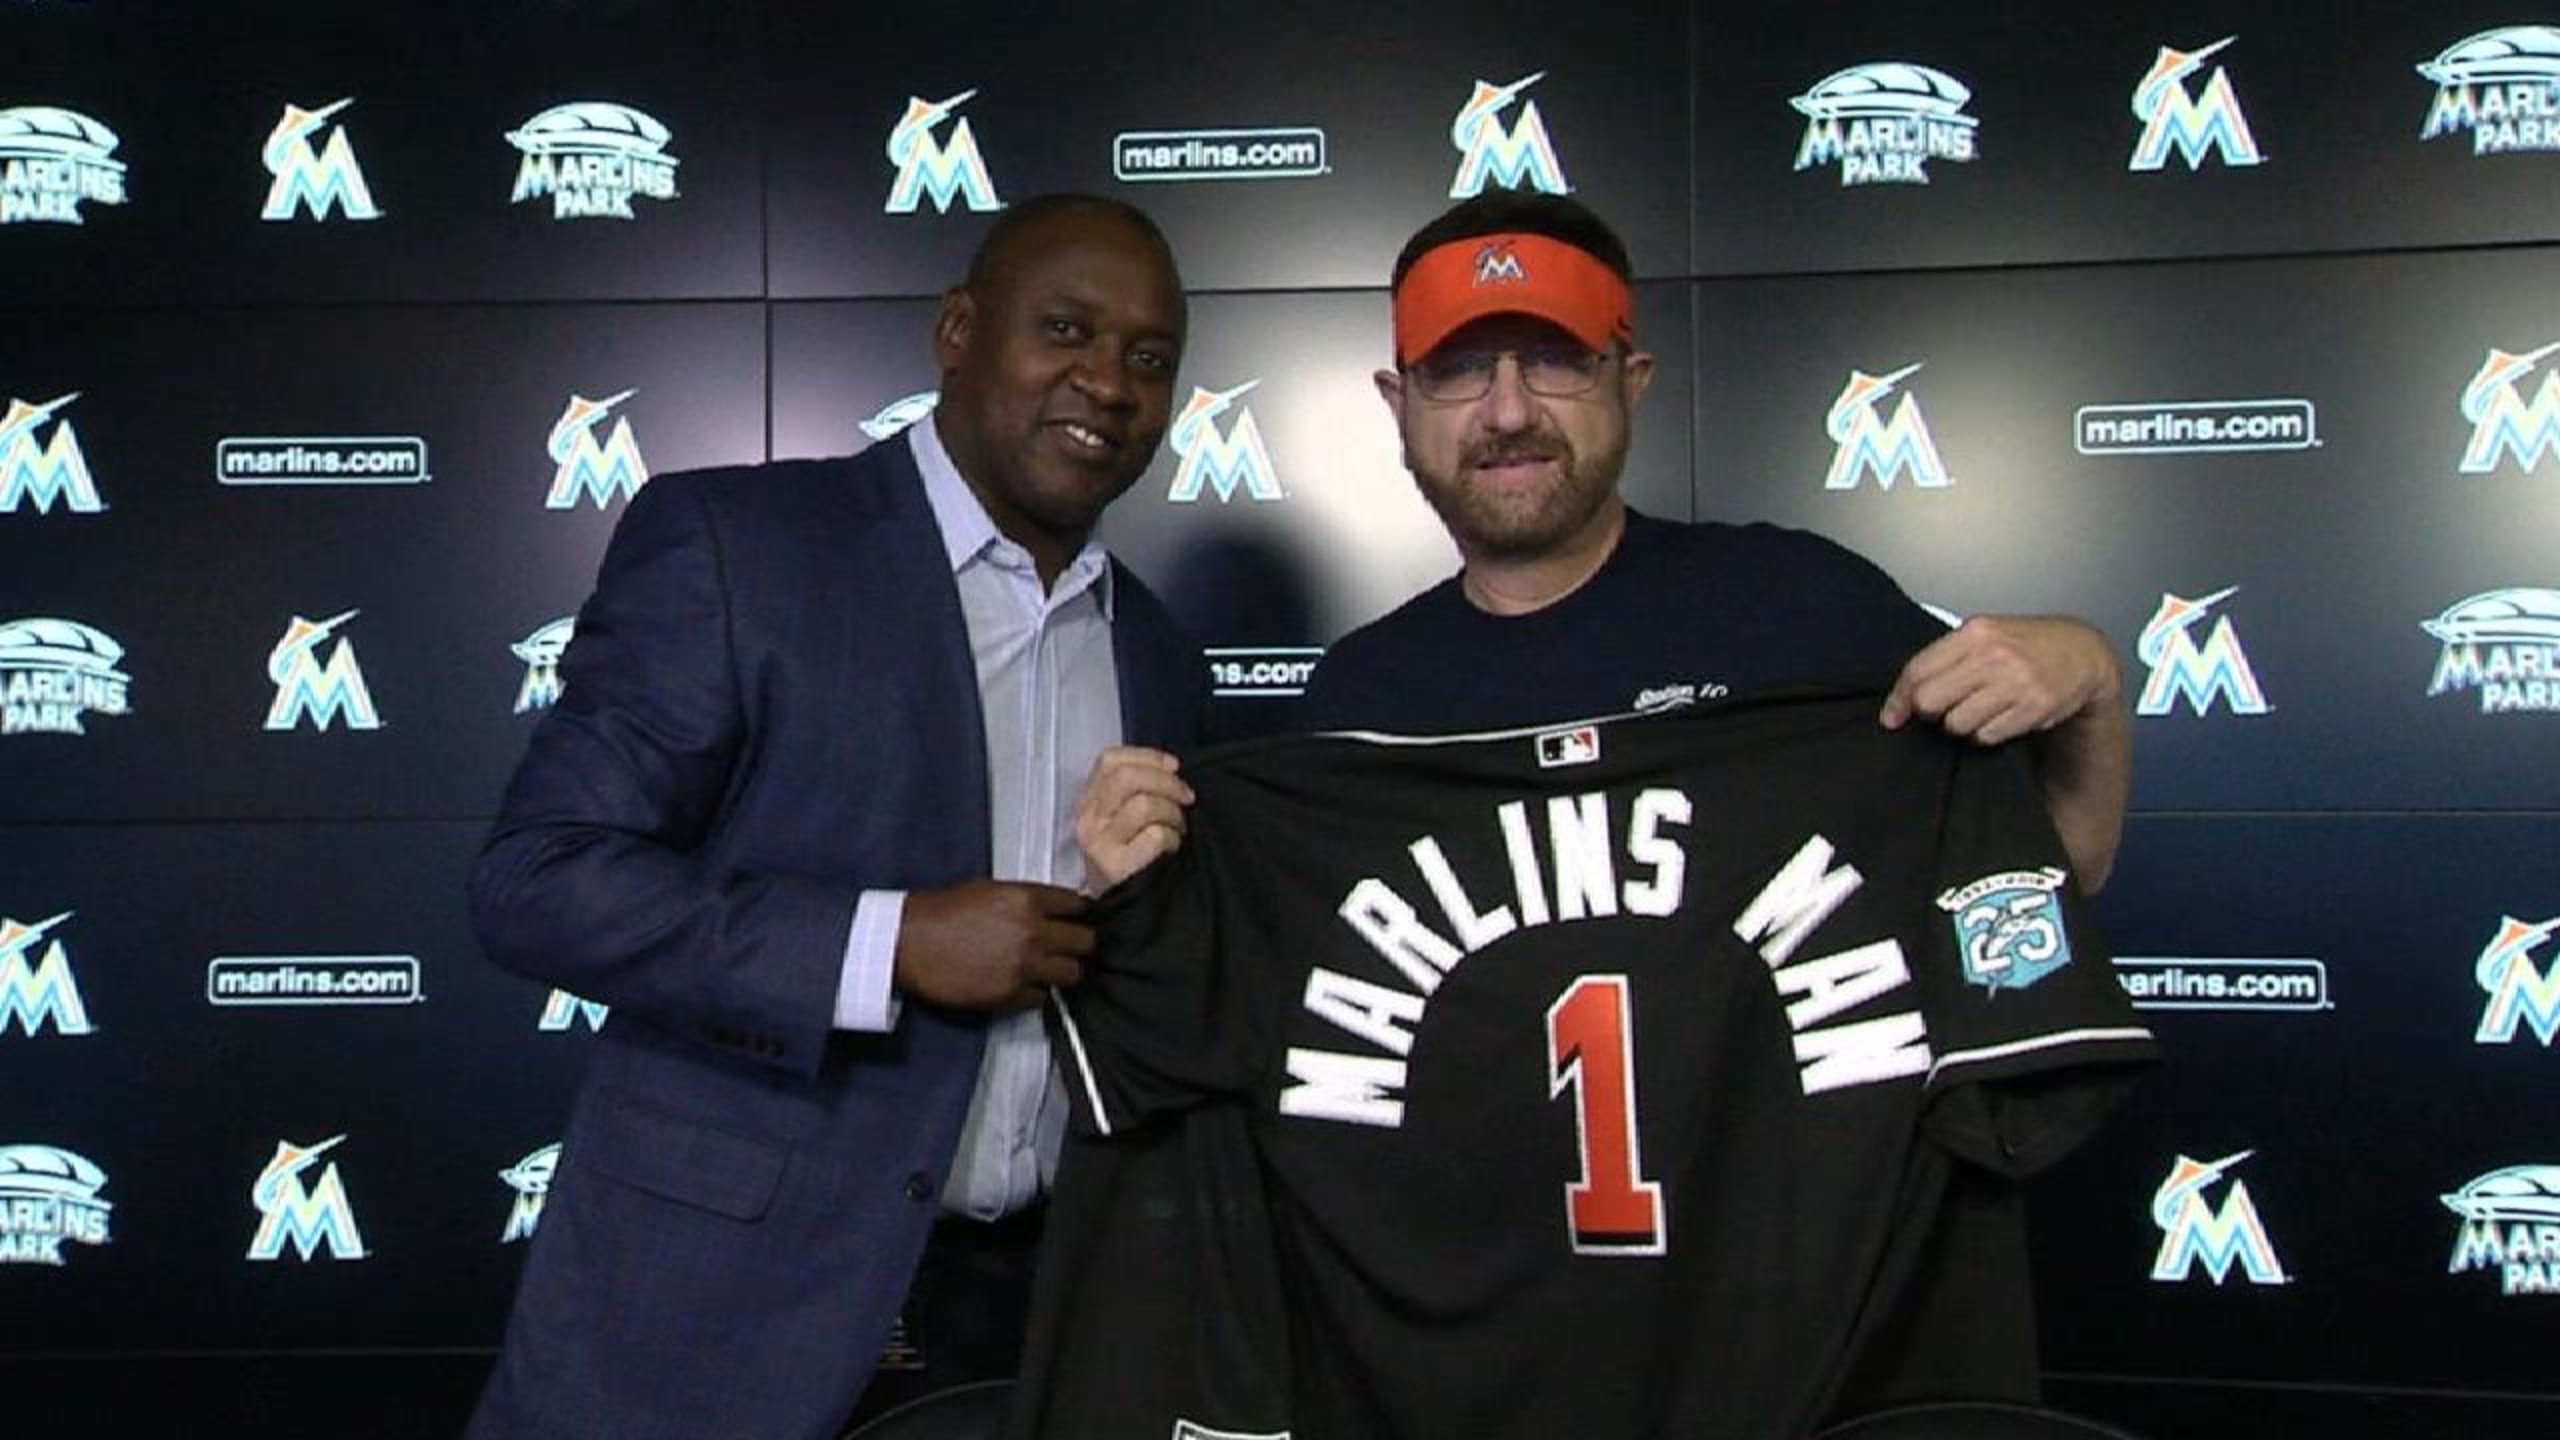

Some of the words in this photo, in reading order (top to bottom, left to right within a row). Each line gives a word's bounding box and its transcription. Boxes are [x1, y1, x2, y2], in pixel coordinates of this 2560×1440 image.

[2130, 65, 2261, 171] M
[2420, 82, 2560, 141] MARL
[886, 117, 1000, 213] M
[1123, 138, 1316, 168] marlins.com
[1449, 100, 1568, 197] M
[1793, 116, 1973, 172] MARLINS
[1842, 151, 1929, 187] PARK
[0, 158, 124, 204] ARLINS
[261, 124, 377, 222] M
[511, 151, 676, 203] MARLINS
[0, 191, 83, 224] PARK
[554, 189, 635, 220] PARK
[1168, 404, 1284, 503] M
[1825, 391, 1951, 491] M
[2086, 410, 2303, 443] marlins.com
[226, 447, 415, 474] marlins.com
[0, 668, 126, 714] ARLINS
[264, 636, 381, 732] M
[2137, 614, 2269, 717] M
[2426, 642, 2560, 696] MARL
[1, 703, 85, 735] PARK
[2482, 680, 2560, 714] PAR
[1280, 787, 1693, 1128] MARLINS
[1732, 832, 1933, 1097] MAN
[1962, 892, 2058, 974] 25
[217, 966, 409, 994] marlins.com
[1546, 974, 1667, 1257] 1
[246, 1162, 365, 1262] M
[2150, 1180, 2287, 1285] M
[0, 1231, 65, 1265] ARK
